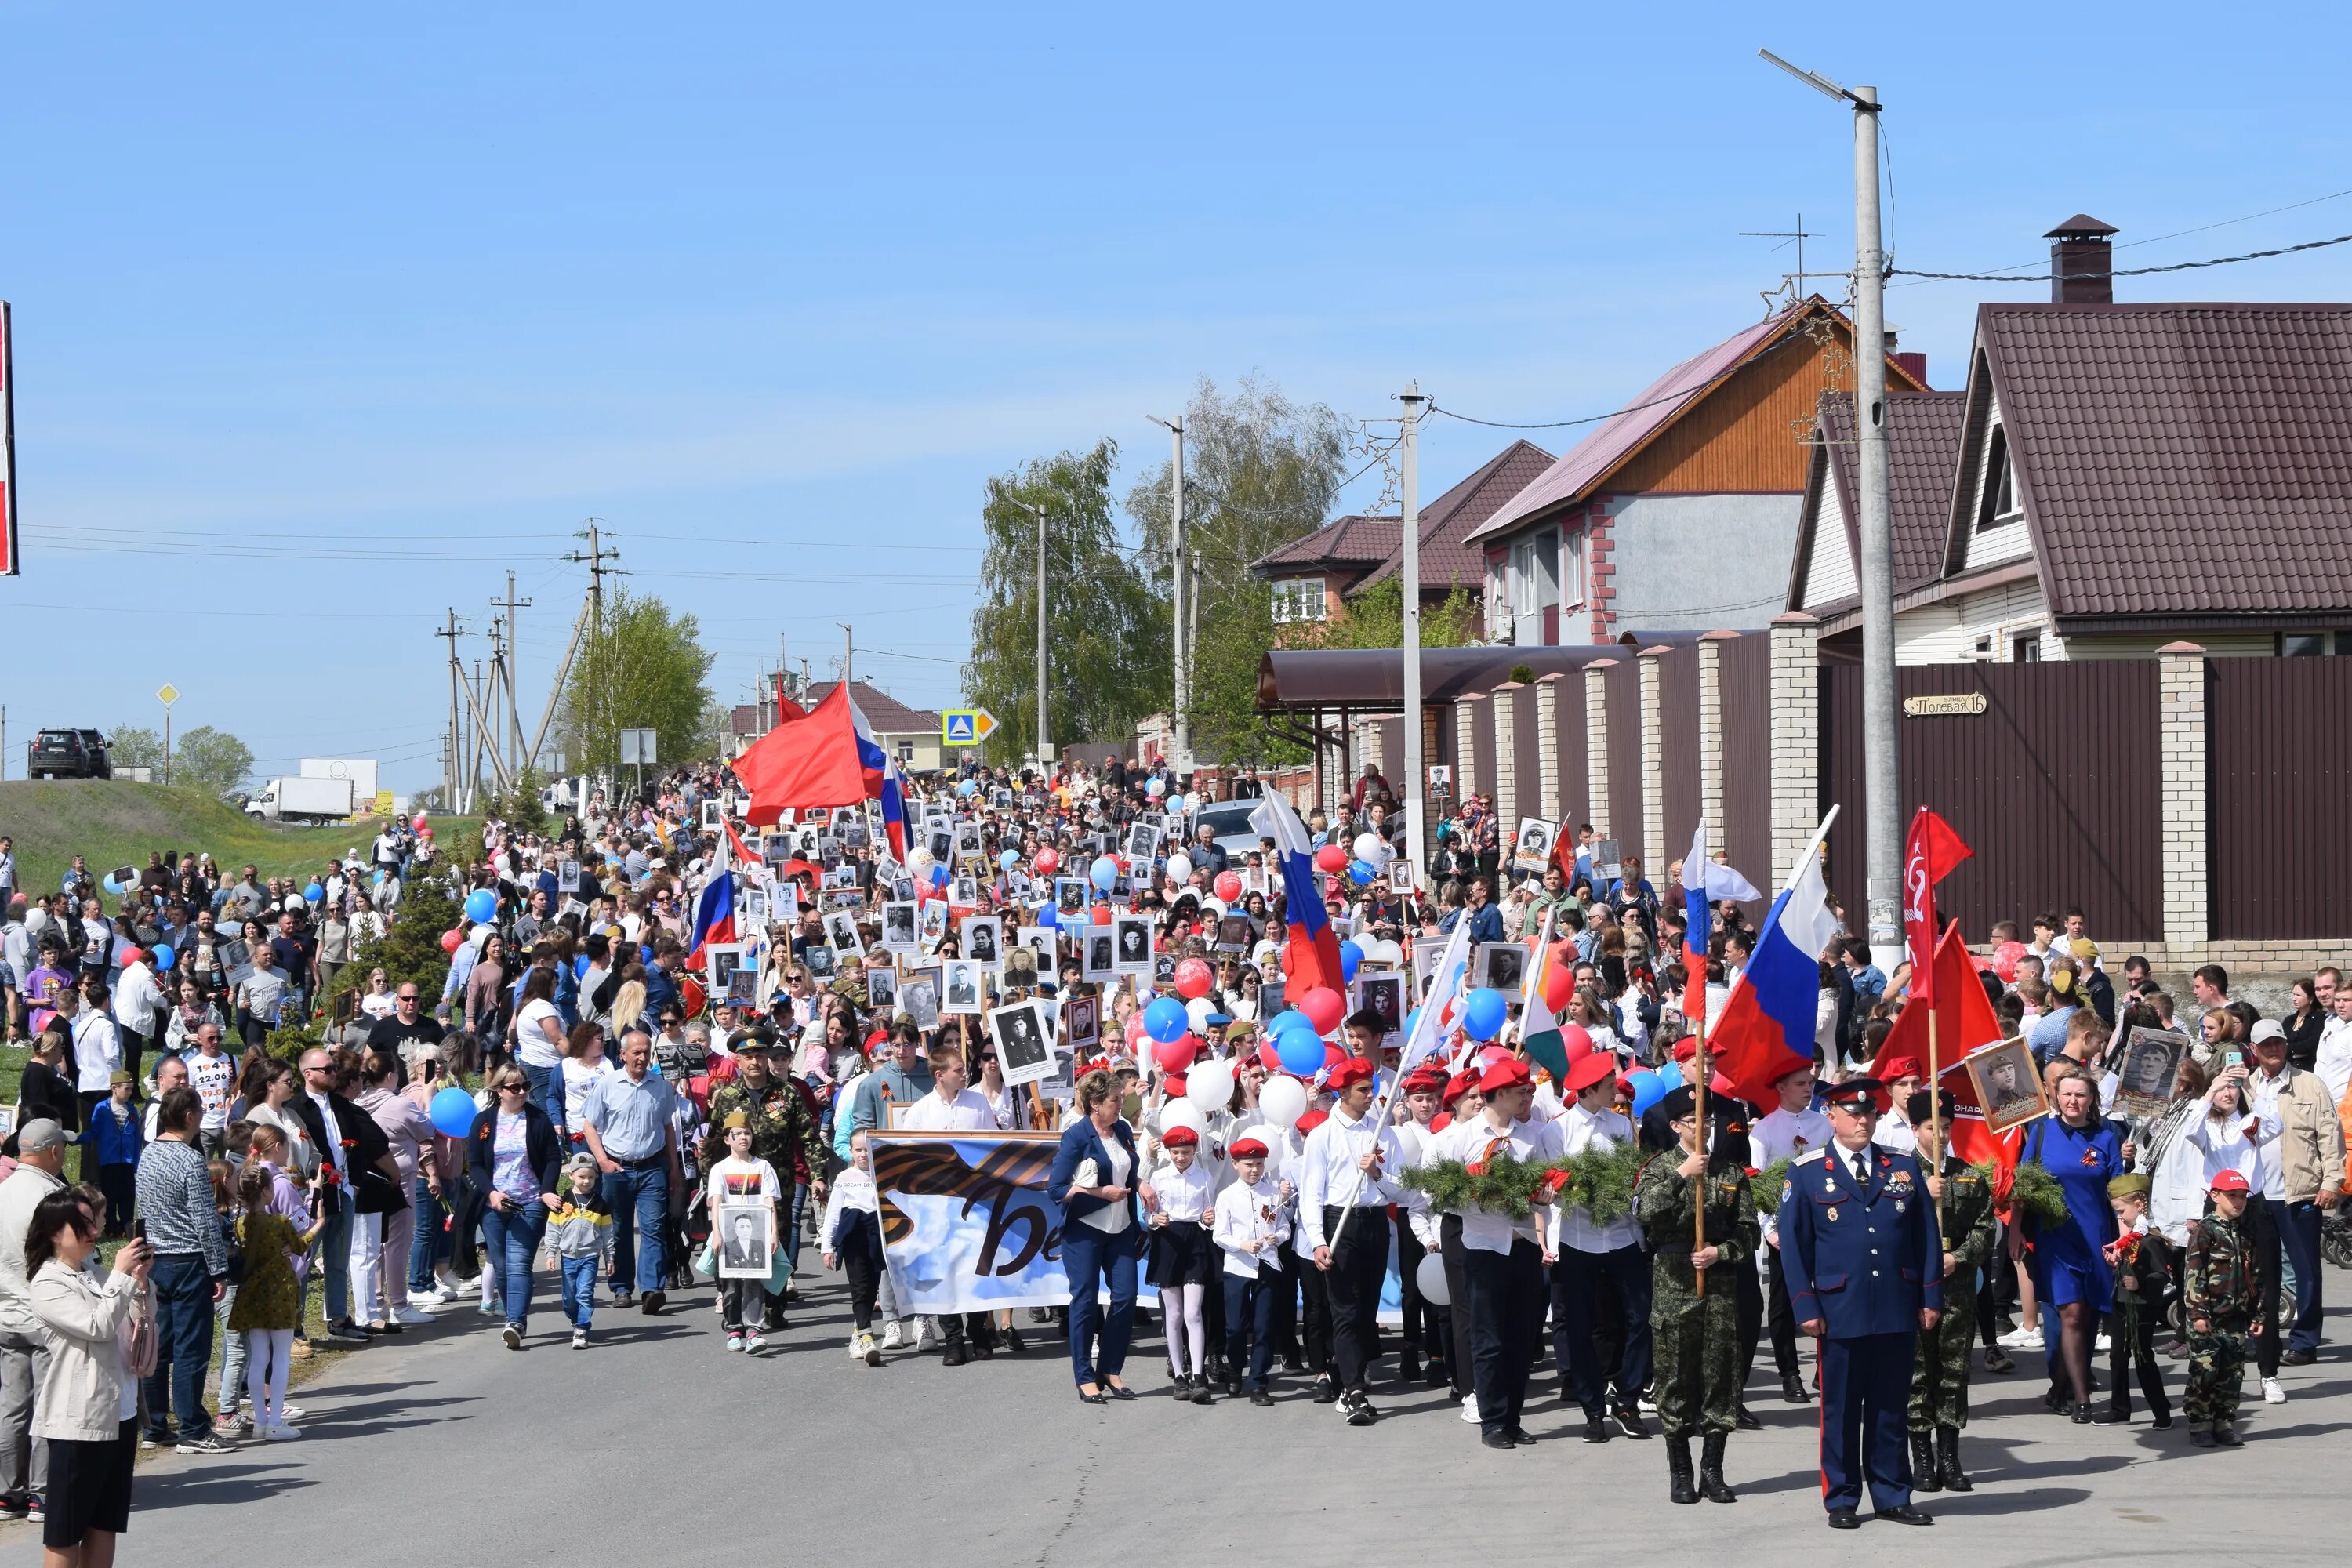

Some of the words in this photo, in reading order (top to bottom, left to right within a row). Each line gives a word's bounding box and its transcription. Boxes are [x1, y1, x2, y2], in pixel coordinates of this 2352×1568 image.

[1916, 698, 1966, 713] Полевая
[1971, 695, 1984, 712] 16
[198, 1073, 227, 1083] 22.06
[201, 1087, 227, 1098] 09.05
